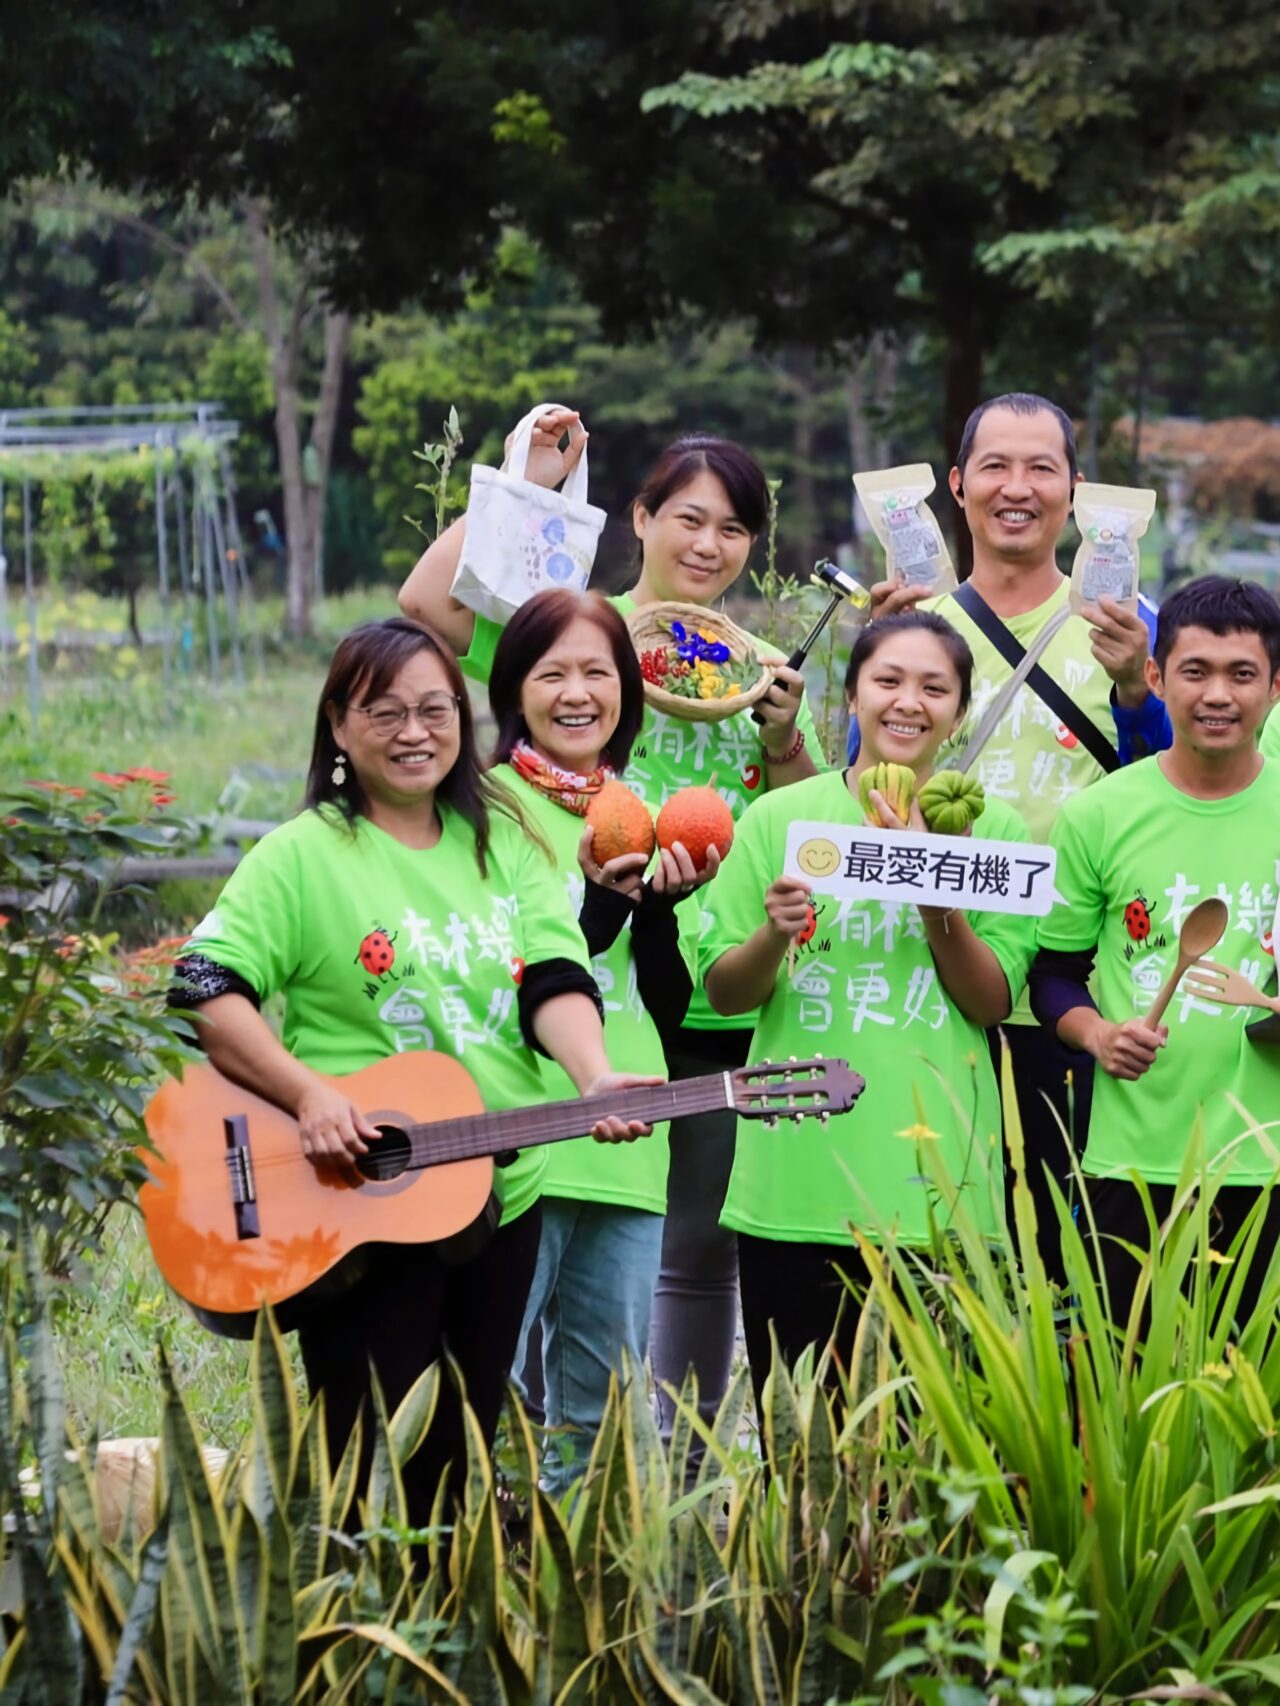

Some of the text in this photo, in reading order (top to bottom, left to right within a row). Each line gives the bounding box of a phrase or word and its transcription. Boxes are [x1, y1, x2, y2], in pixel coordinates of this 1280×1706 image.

[645, 708, 757, 783] 有機
[936, 747, 1078, 804] 更好
[843, 840, 1051, 900] 最愛有機了
[402, 902, 522, 977] 有機
[792, 956, 950, 1033] 會更好
